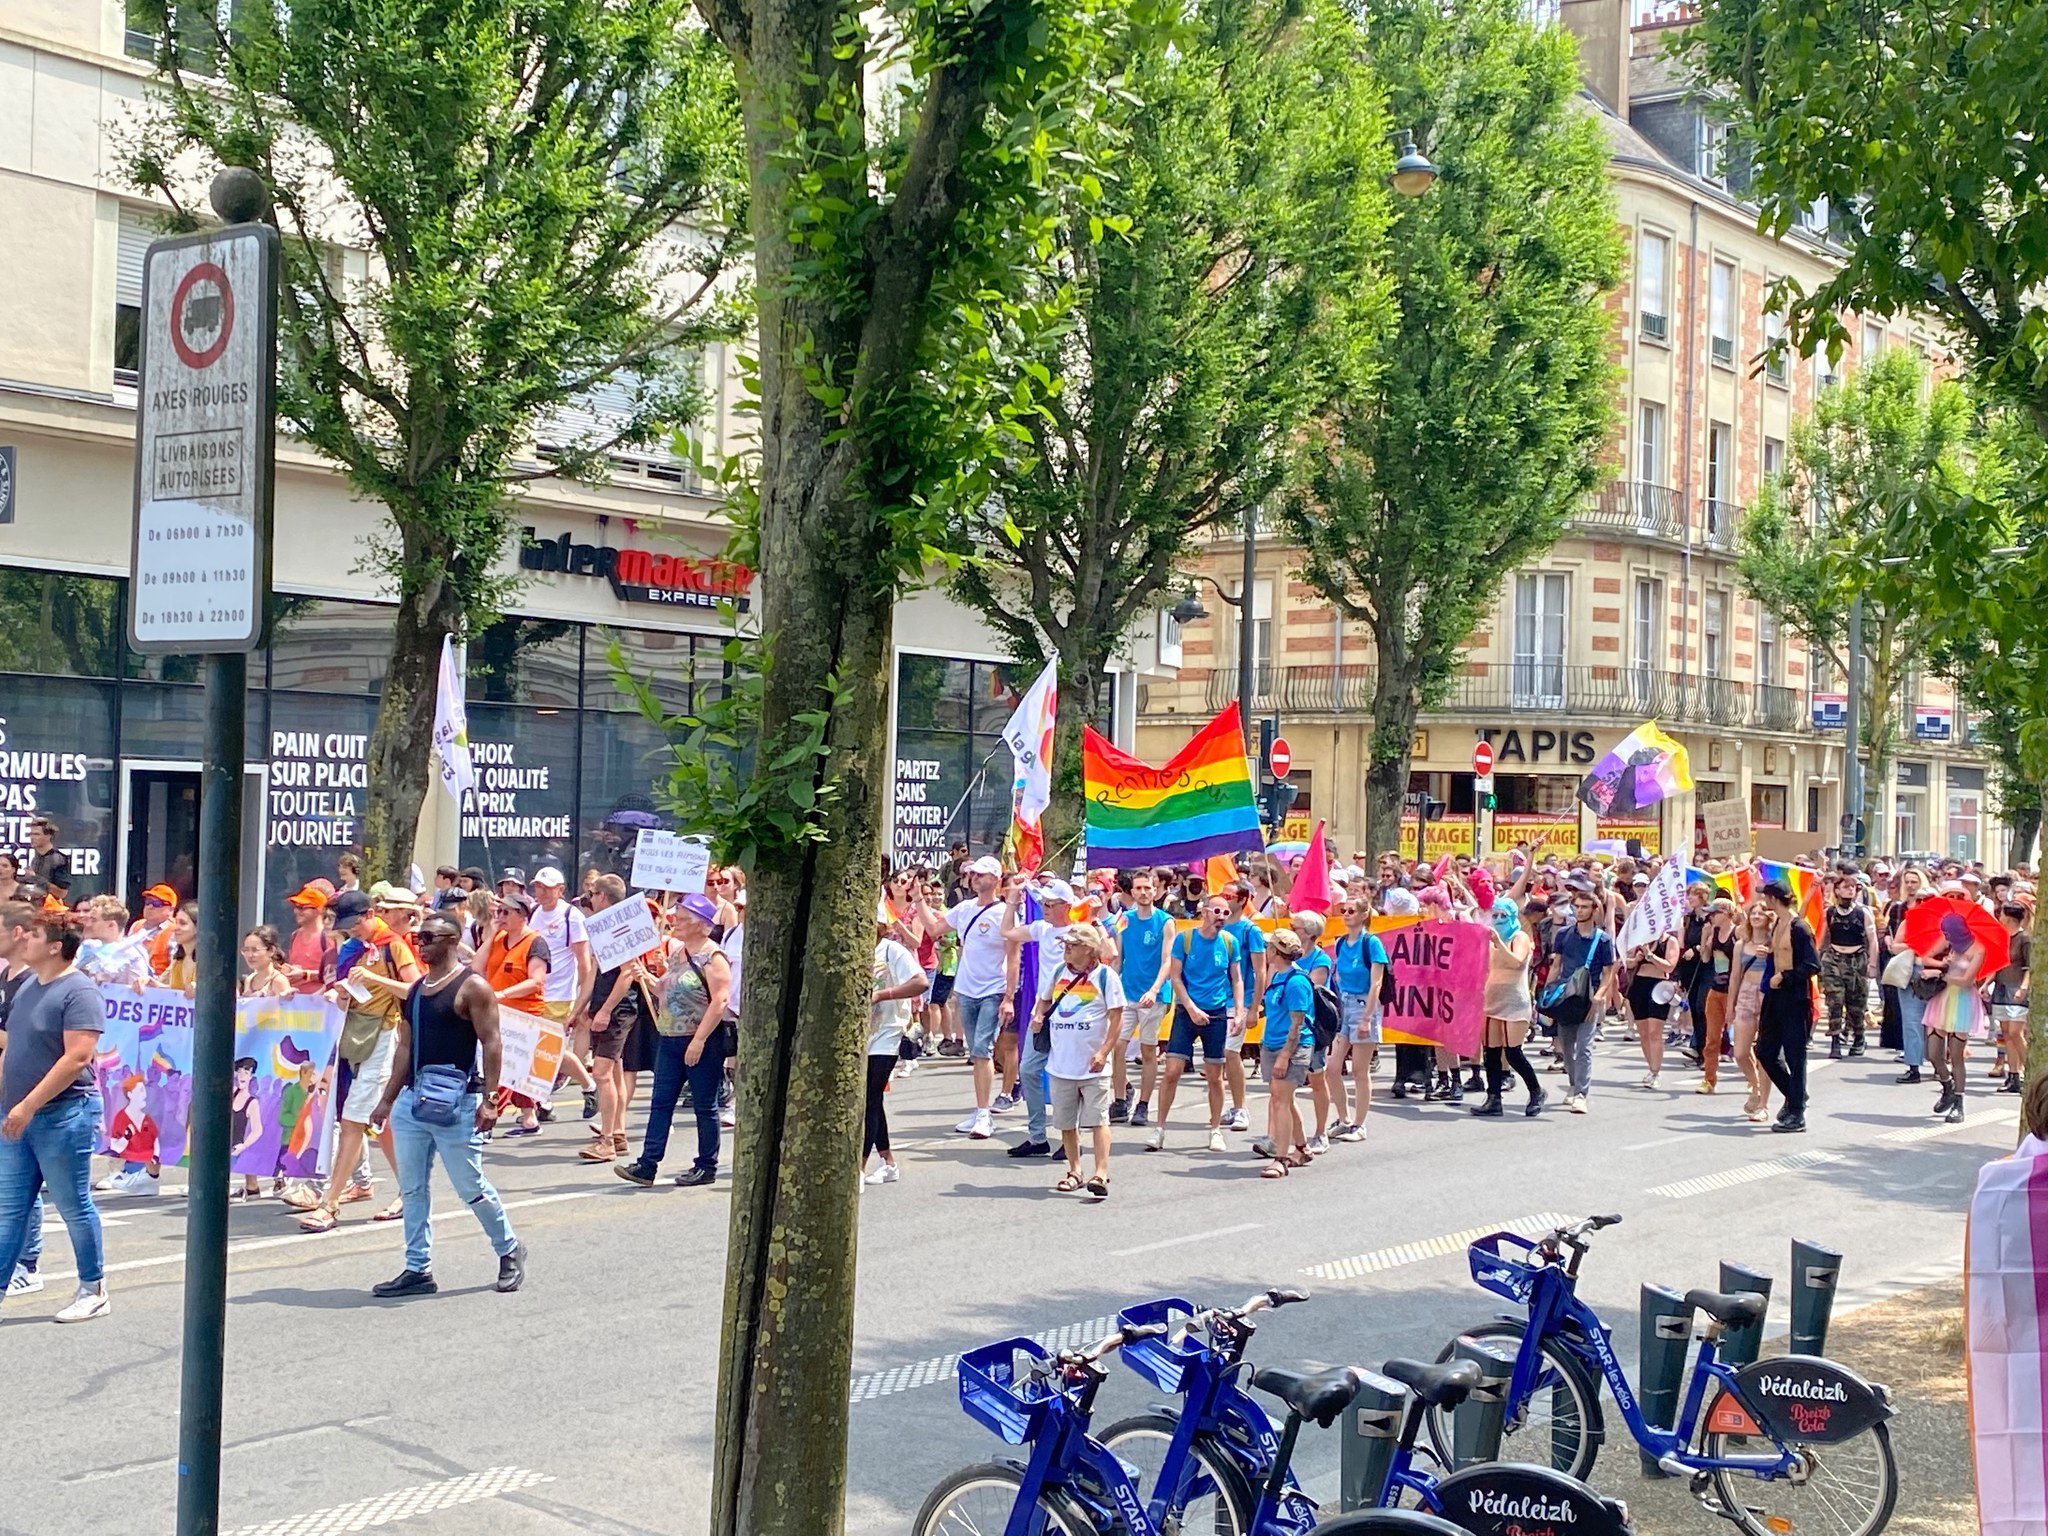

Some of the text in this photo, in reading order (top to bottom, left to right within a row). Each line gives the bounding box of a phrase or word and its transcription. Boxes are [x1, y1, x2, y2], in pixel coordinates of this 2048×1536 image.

[152, 382, 248, 413] AXES ROUGES
[161, 440, 235, 463] LIVRAISONS
[148, 524, 244, 541] De 06h00 à 7h30
[144, 568, 245, 585] De 09h00 à 11h30
[142, 609, 245, 624] De 18h30 à 22h00
[273, 731, 367, 759] PAIN CUIT
[1475, 729, 1595, 763] TAPIS
[271, 761, 310, 786] SUR
[485, 767, 549, 791] QUALITÉ
[896, 760, 940, 780] PARTEZ
[896, 783, 926, 802] SANS
[1096, 768, 1190, 812] Rennes
[270, 791, 355, 816] TOUTE LA
[480, 792, 516, 813] PRIX
[462, 815, 571, 838] INTERMARCHÉ
[895, 806, 941, 825] PORTER
[268, 818, 353, 845] JOURNÉE
[895, 829, 945, 848] ON LIVRE
[1400, 827, 1470, 844] TOKAGE
[1712, 827, 1741, 841] ACAB
[105, 999, 143, 1023] DES
[1589, 1327, 1631, 1410] STAR le vélo
[1759, 1375, 1848, 1402] Pédaleizh
[1790, 1403, 1832, 1421] Breizh
[1798, 1418, 1826, 1433] Cola
[1115, 1484, 1147, 1533] STAR
[1469, 1489, 1577, 1523] Pédaleizh
